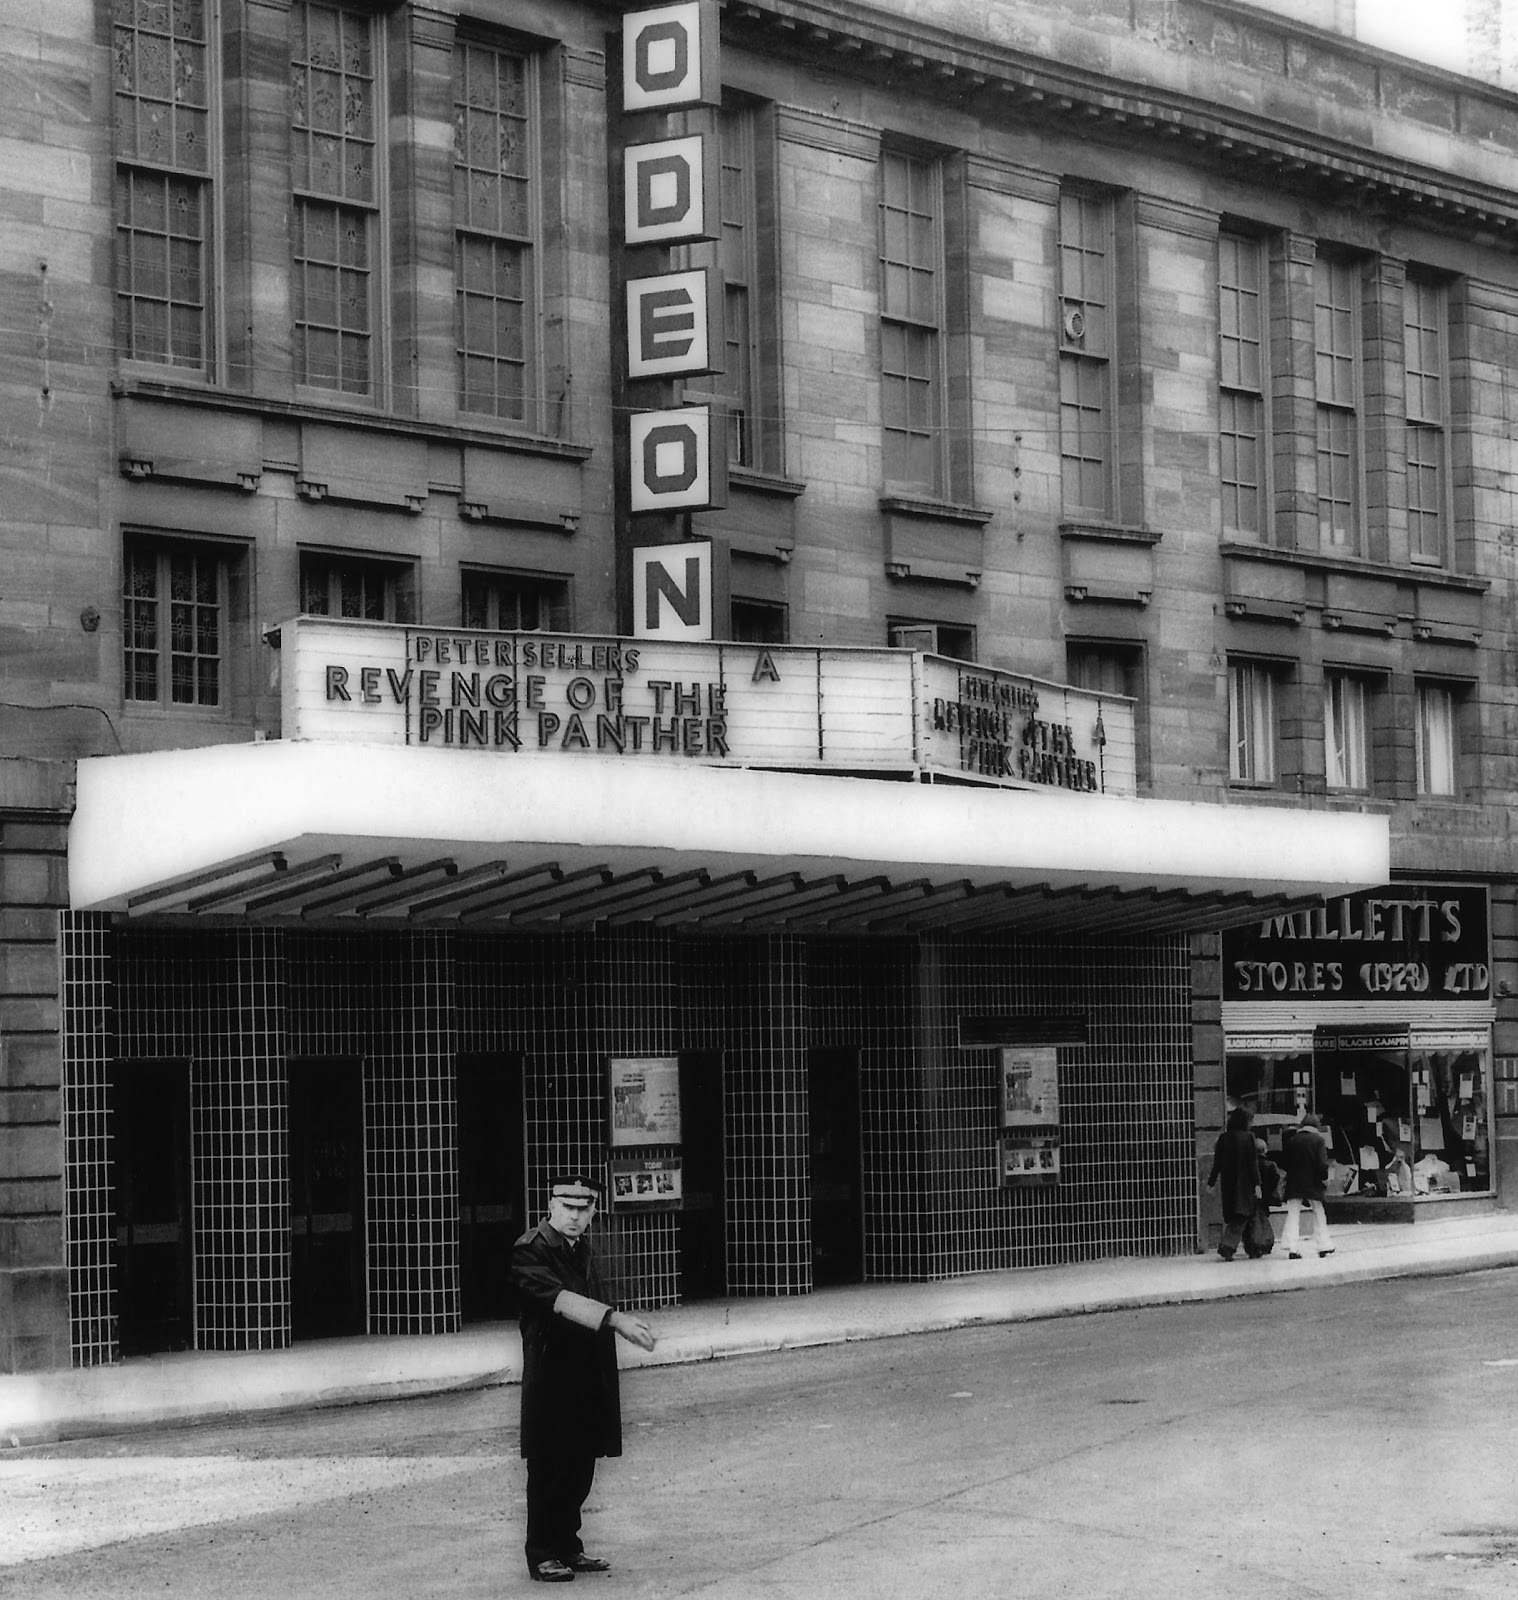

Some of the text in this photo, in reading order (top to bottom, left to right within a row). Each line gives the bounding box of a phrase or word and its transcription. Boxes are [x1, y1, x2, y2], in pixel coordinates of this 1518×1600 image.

[635, 19, 699, 630] ODEON
[416, 636, 641, 673] PETER SELLERS
[751, 650, 780, 682] A
[325, 665, 728, 718] REVENGE OF THE
[418, 708, 730, 756] PINK PANTHER
[1234, 960, 1489, 994] STORES (1928) LTD
